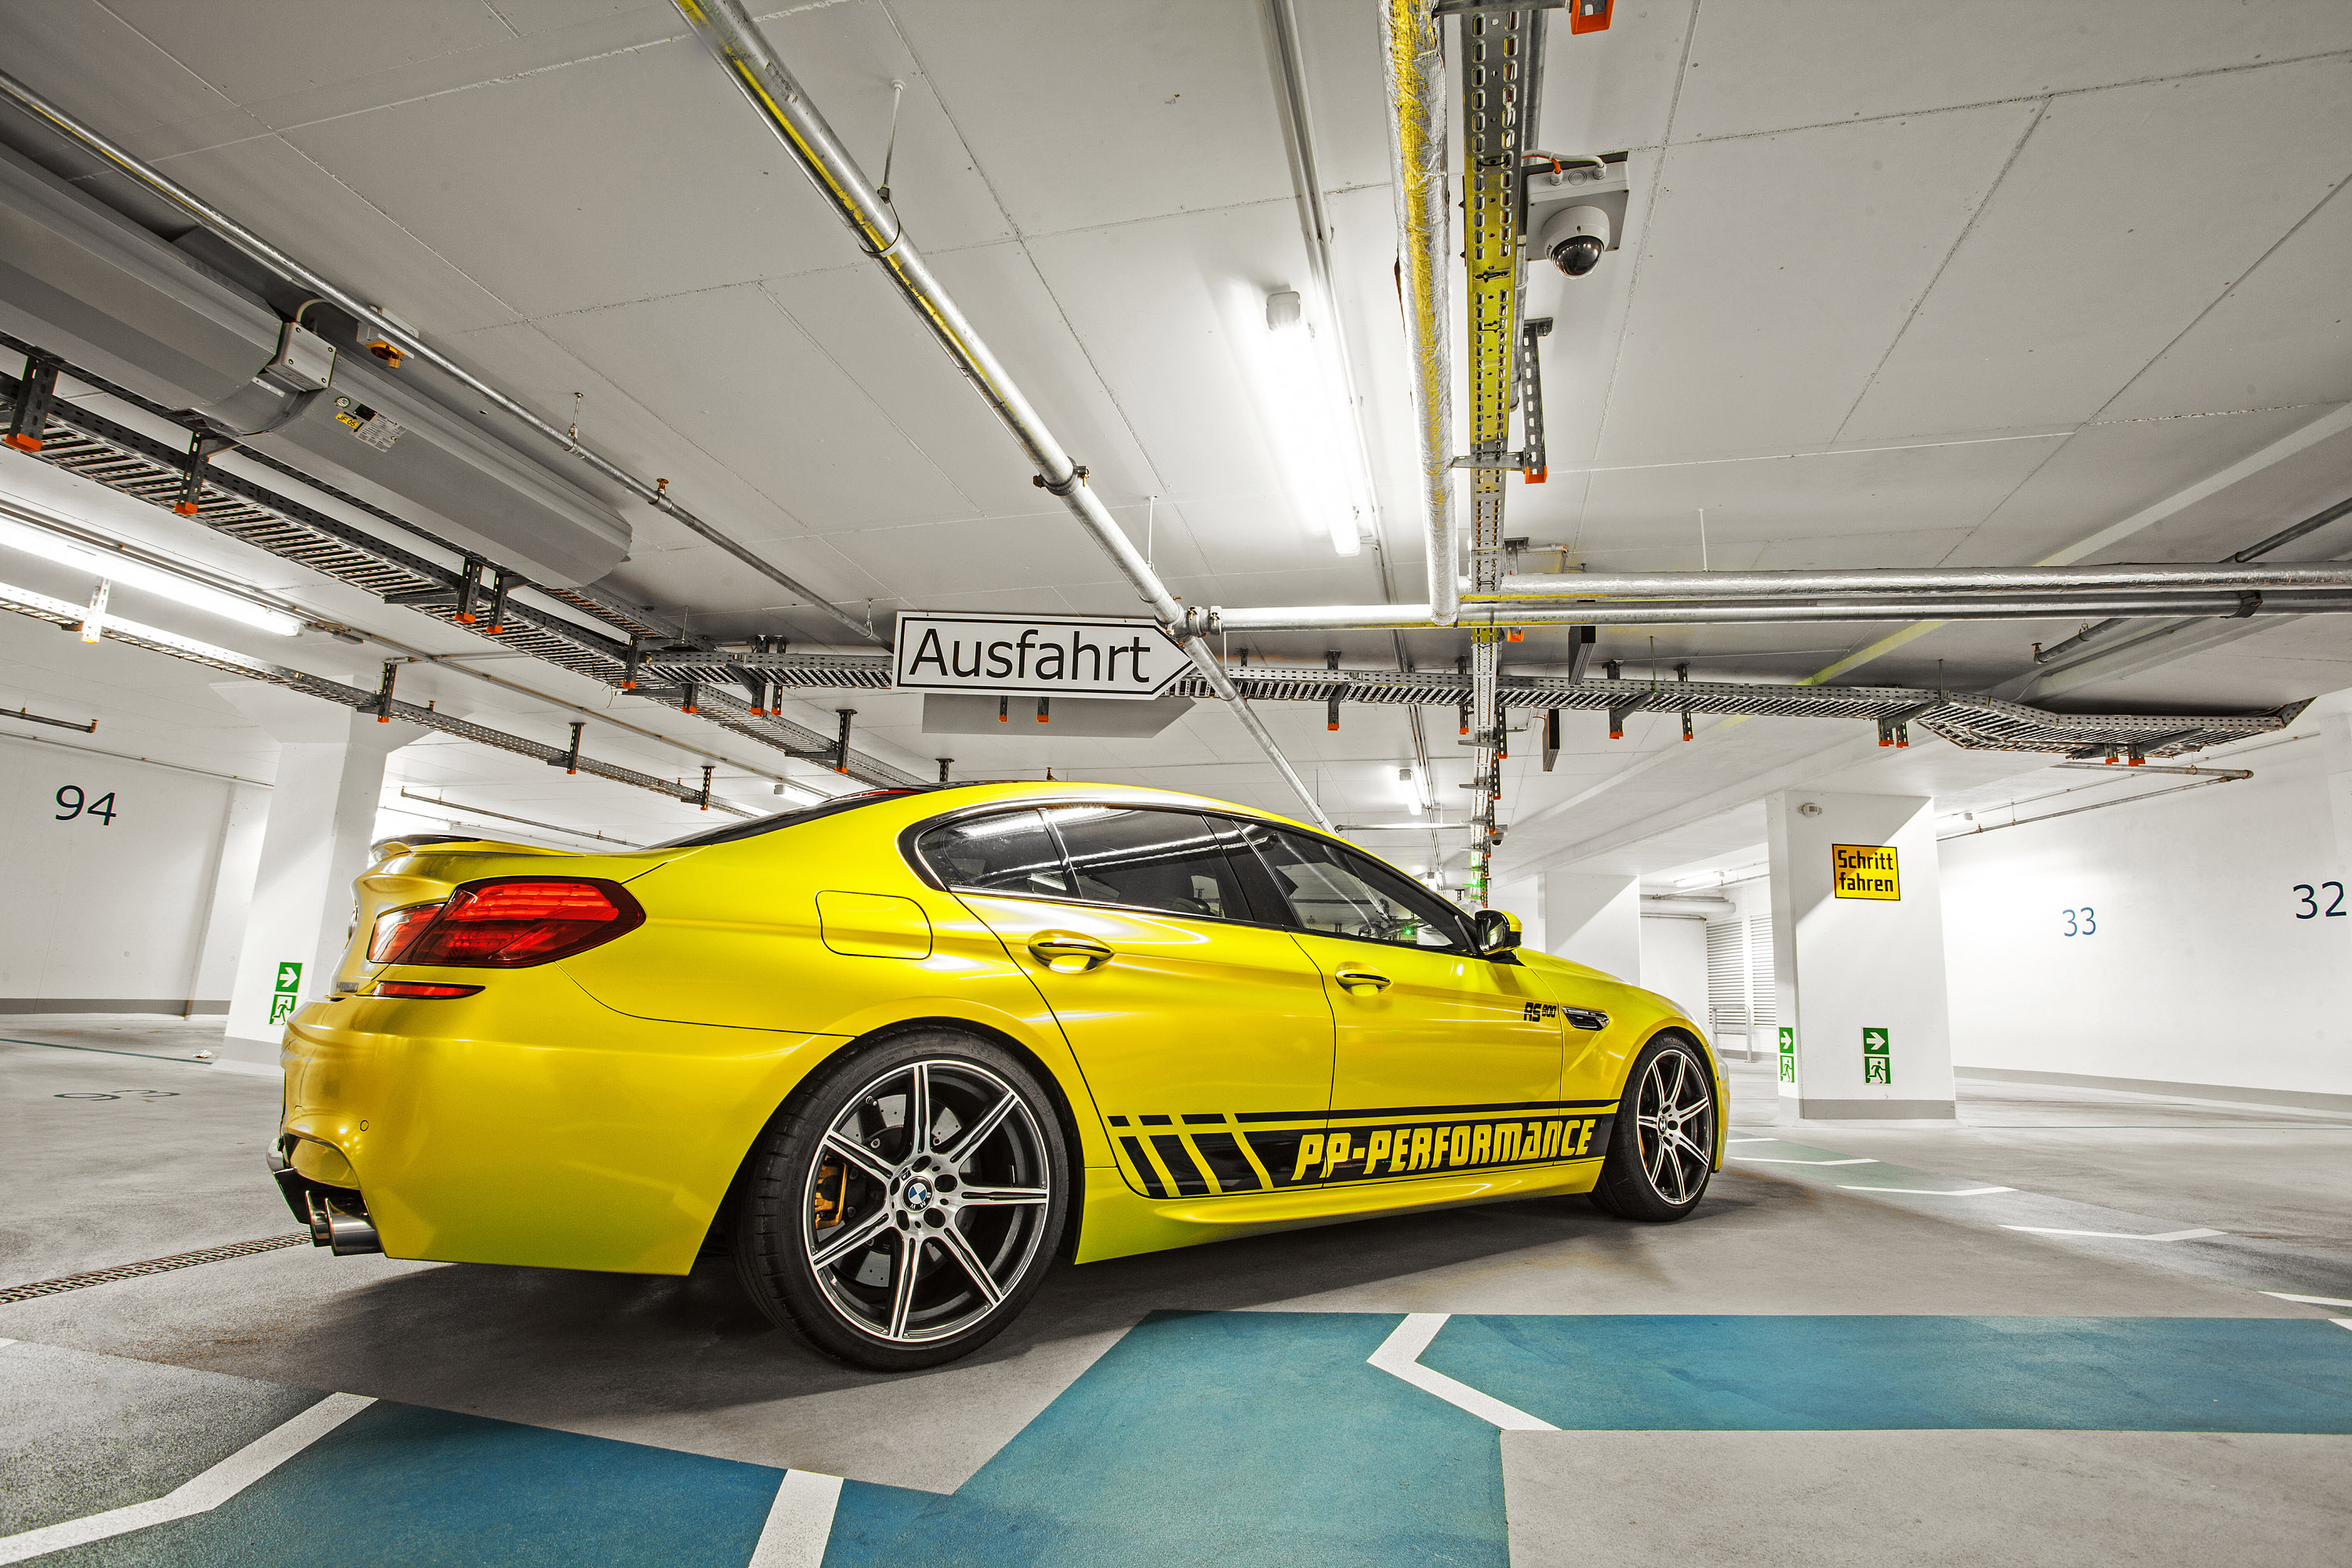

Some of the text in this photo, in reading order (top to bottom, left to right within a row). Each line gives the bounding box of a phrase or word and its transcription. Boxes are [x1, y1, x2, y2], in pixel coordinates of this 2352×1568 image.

[347, 419, 358, 427] 05
[909, 628, 1151, 683] Ausfahrt
[55, 785, 117, 826] 94
[1838, 849, 1894, 870] Schritt
[1838, 872, 1894, 892] fahren
[2292, 880, 2347, 920] 32
[2062, 906, 2096, 937] 33
[1290, 1119, 1596, 1181] PP-PERFORMANCE
